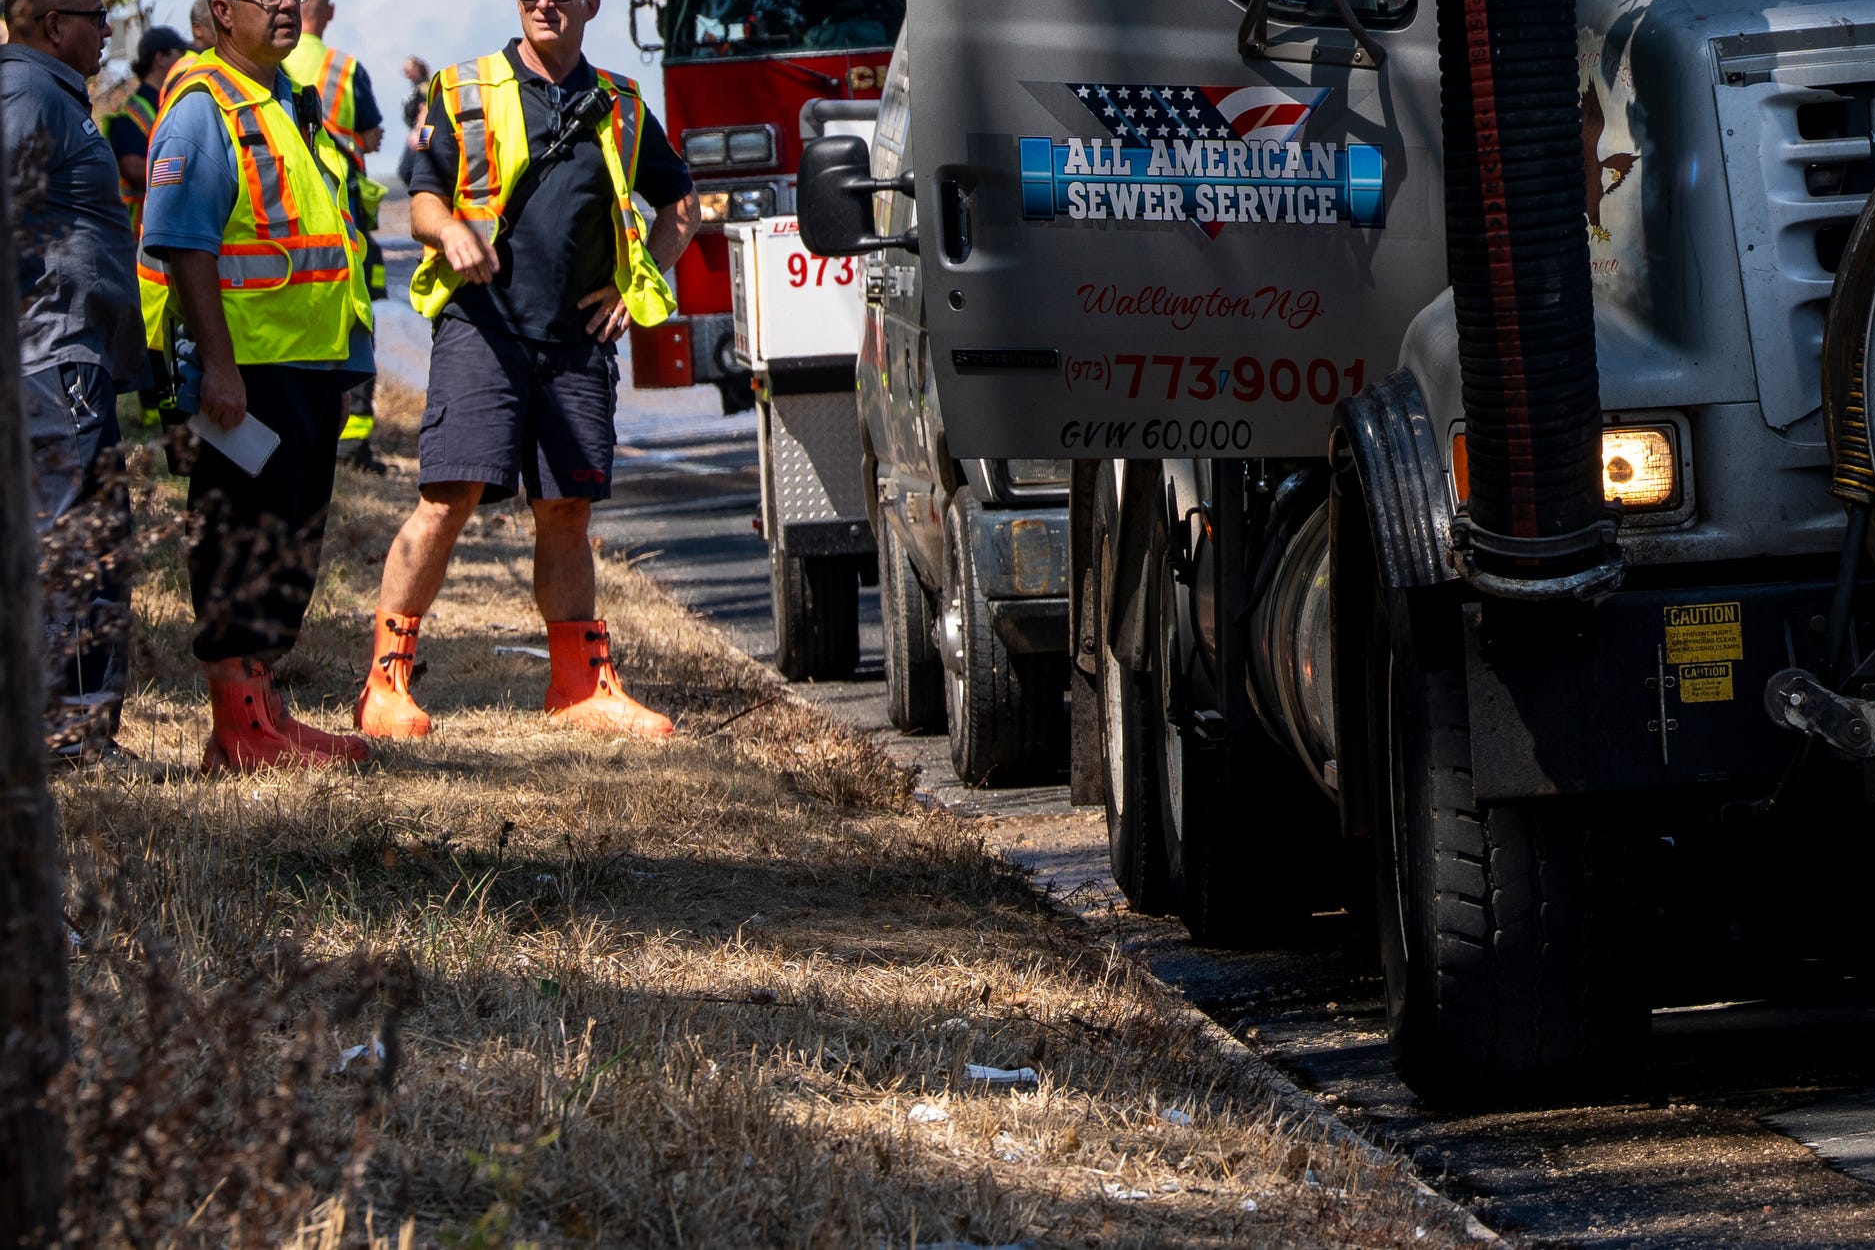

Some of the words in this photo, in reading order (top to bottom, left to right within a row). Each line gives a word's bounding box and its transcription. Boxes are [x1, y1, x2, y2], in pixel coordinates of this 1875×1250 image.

[1064, 138, 1131, 176] ALL
[1146, 138, 1337, 180] AMERICAN
[1067, 181, 1187, 221] SEWER
[1195, 184, 1338, 225] SERVICE
[1077, 284, 1256, 331] Wallington,
[955, 351, 1055, 365] STERLING
[1064, 355, 1112, 392] (973)
[1060, 420, 1137, 449] GVW
[1142, 419, 1253, 453] 60,000
[1670, 605, 1735, 626] CAUTION
[1684, 666, 1726, 679] CAUTION
